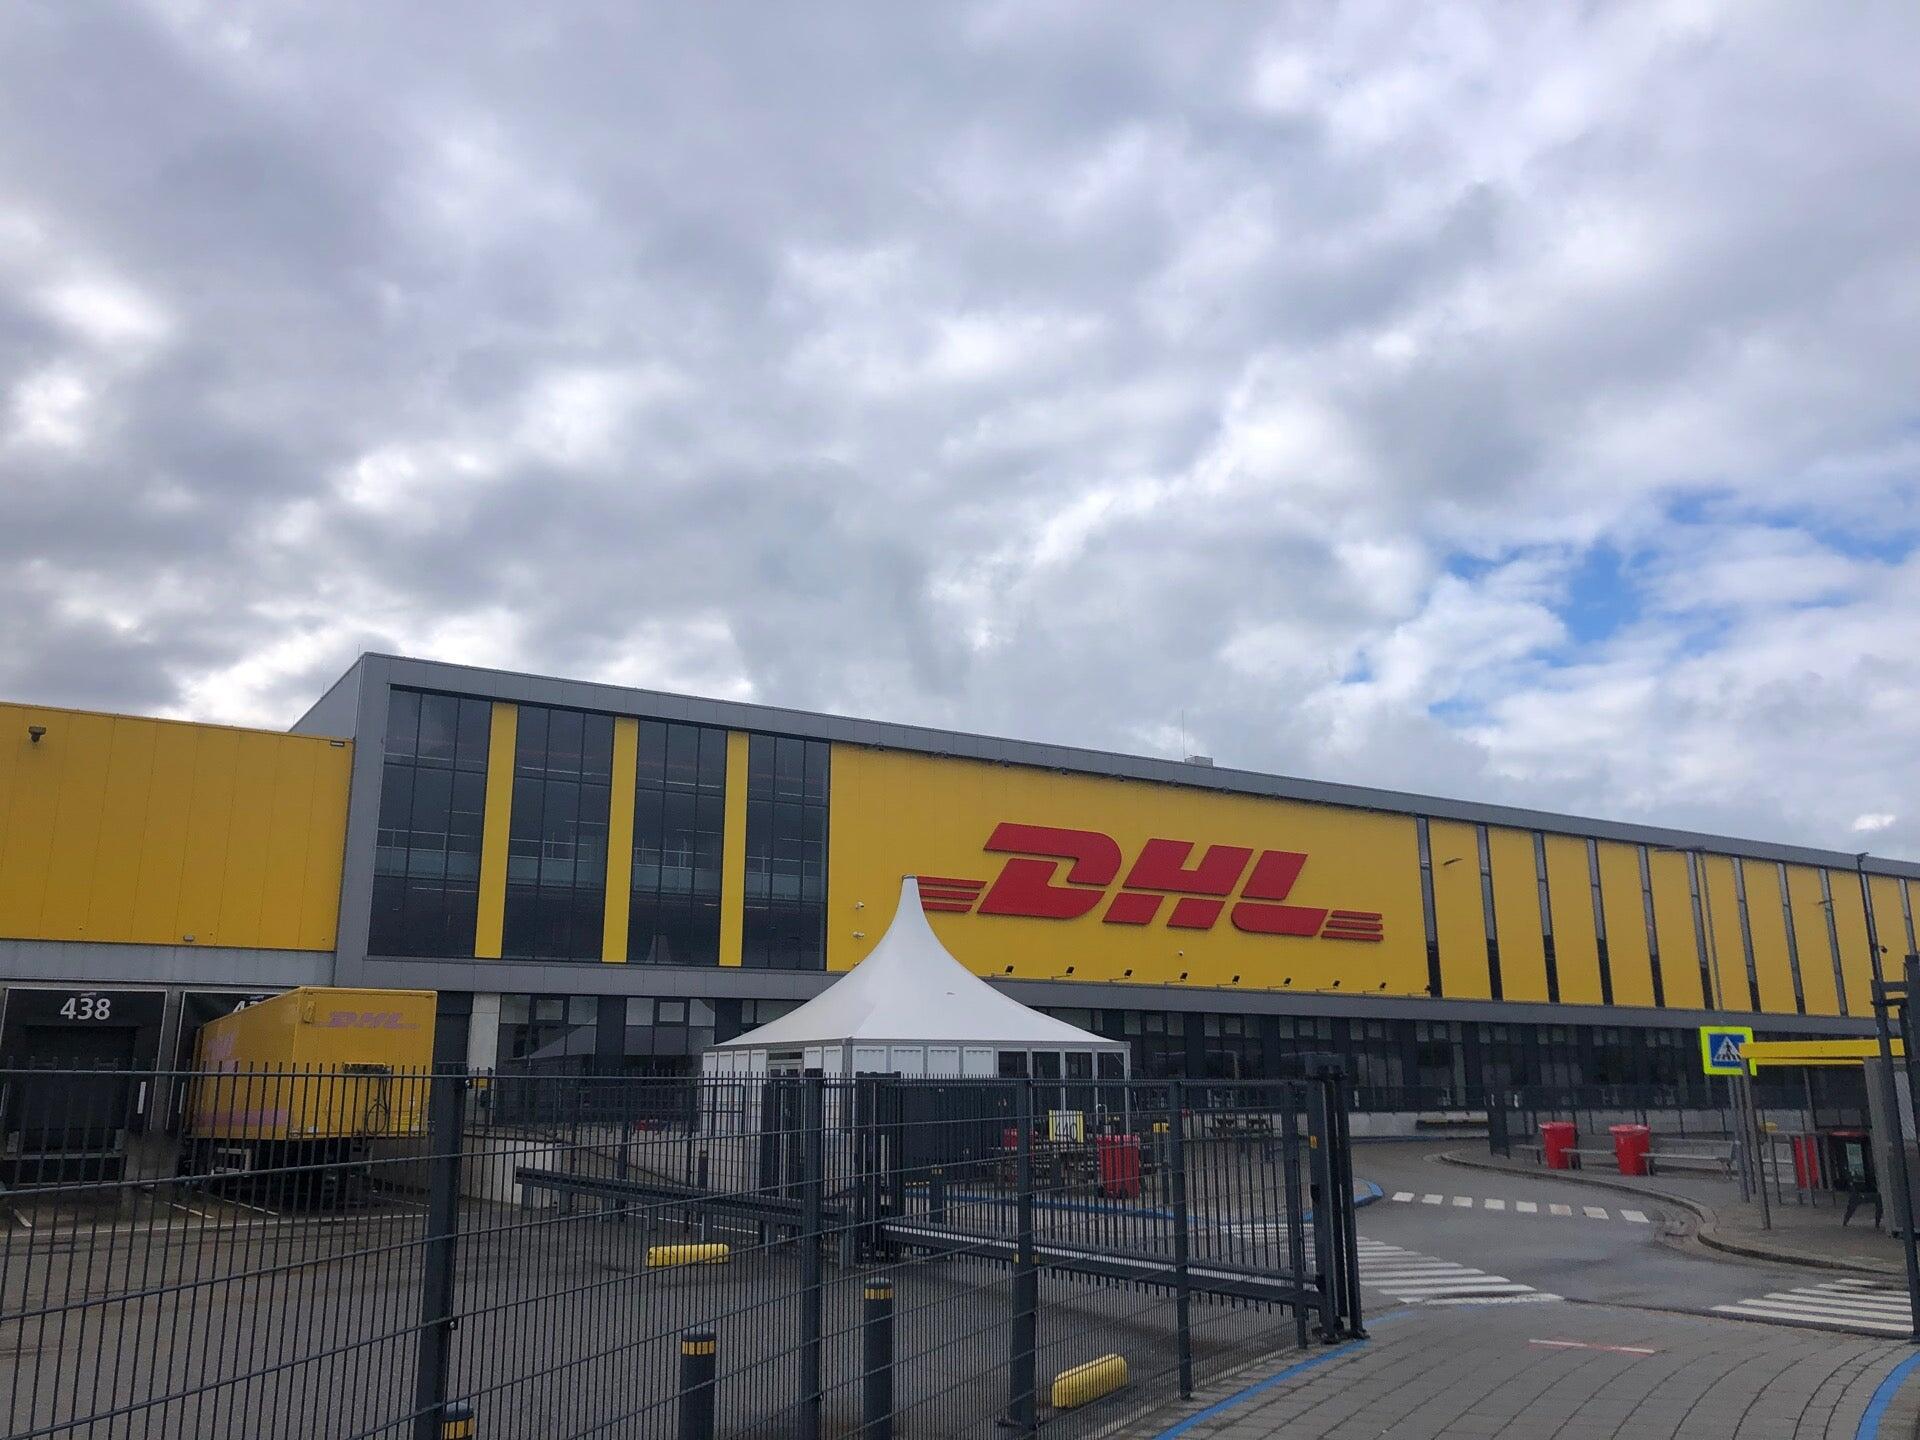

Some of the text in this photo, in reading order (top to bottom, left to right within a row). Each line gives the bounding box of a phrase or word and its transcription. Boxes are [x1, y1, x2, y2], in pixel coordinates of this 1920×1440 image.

[977, 822, 1328, 937] DHL
[59, 997, 111, 1020] 438
[328, 1010, 403, 1030] DHL
